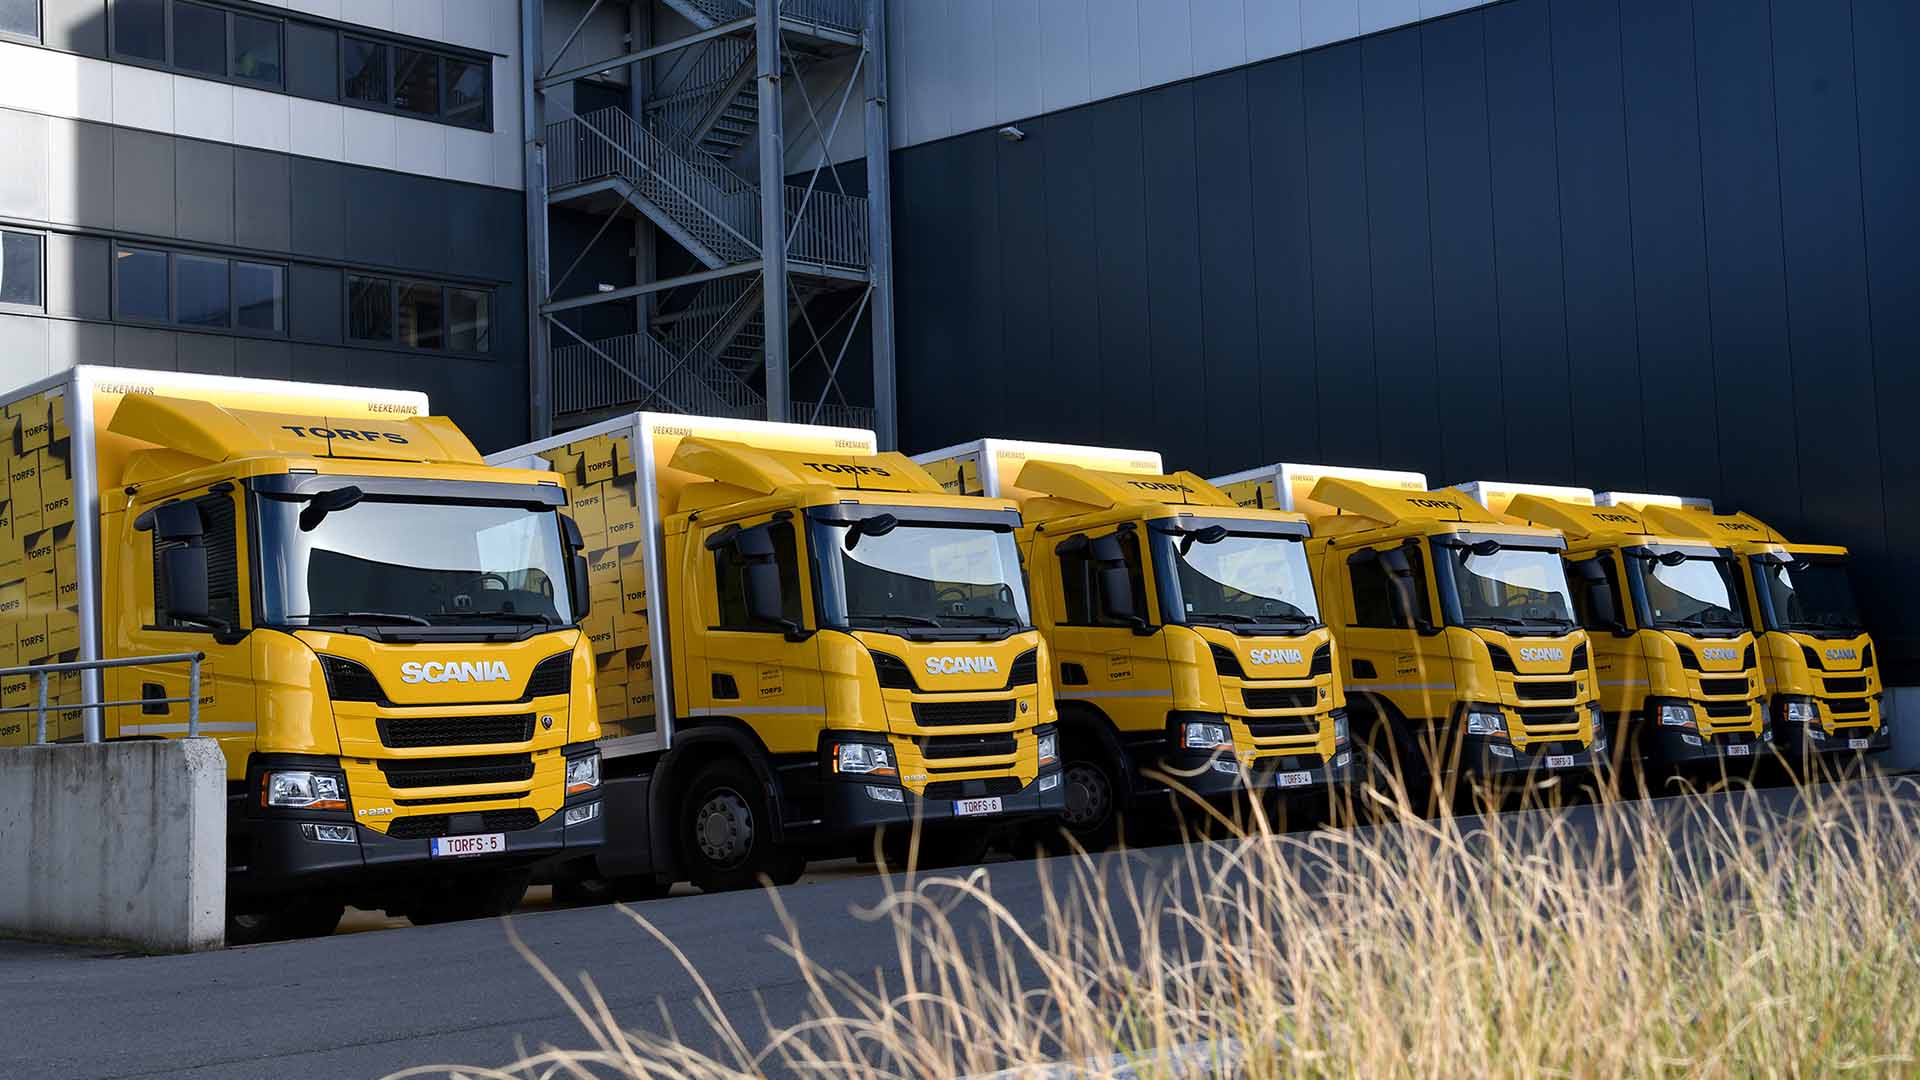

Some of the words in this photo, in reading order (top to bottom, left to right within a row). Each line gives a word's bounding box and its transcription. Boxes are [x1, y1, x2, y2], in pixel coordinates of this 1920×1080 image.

[368, 402, 418, 415] VEEKEMANS
[24, 423, 48, 439] TORFS
[281, 425, 409, 444] TORFS
[587, 459, 612, 473] TORFS
[803, 462, 891, 477] TORFS
[12, 467, 35, 483] TORFS
[1128, 481, 1195, 493] TORFS
[45, 497, 69, 513] TORFS
[575, 496, 599, 509] TORFS
[1406, 499, 1463, 511] TORFS
[609, 521, 634, 534] TORFS
[28, 545, 51, 561] TORFS
[592, 560, 616, 573] TORFS
[0, 599, 20, 612] ORFS
[20, 633, 44, 648] TORFS
[1249, 648, 1304, 665] SCANIA
[1519, 647, 1564, 662] SCANIA
[400, 660, 512, 684] SCANIA
[926, 656, 999, 675] SCANIA
[3, 681, 27, 696] TORFS
